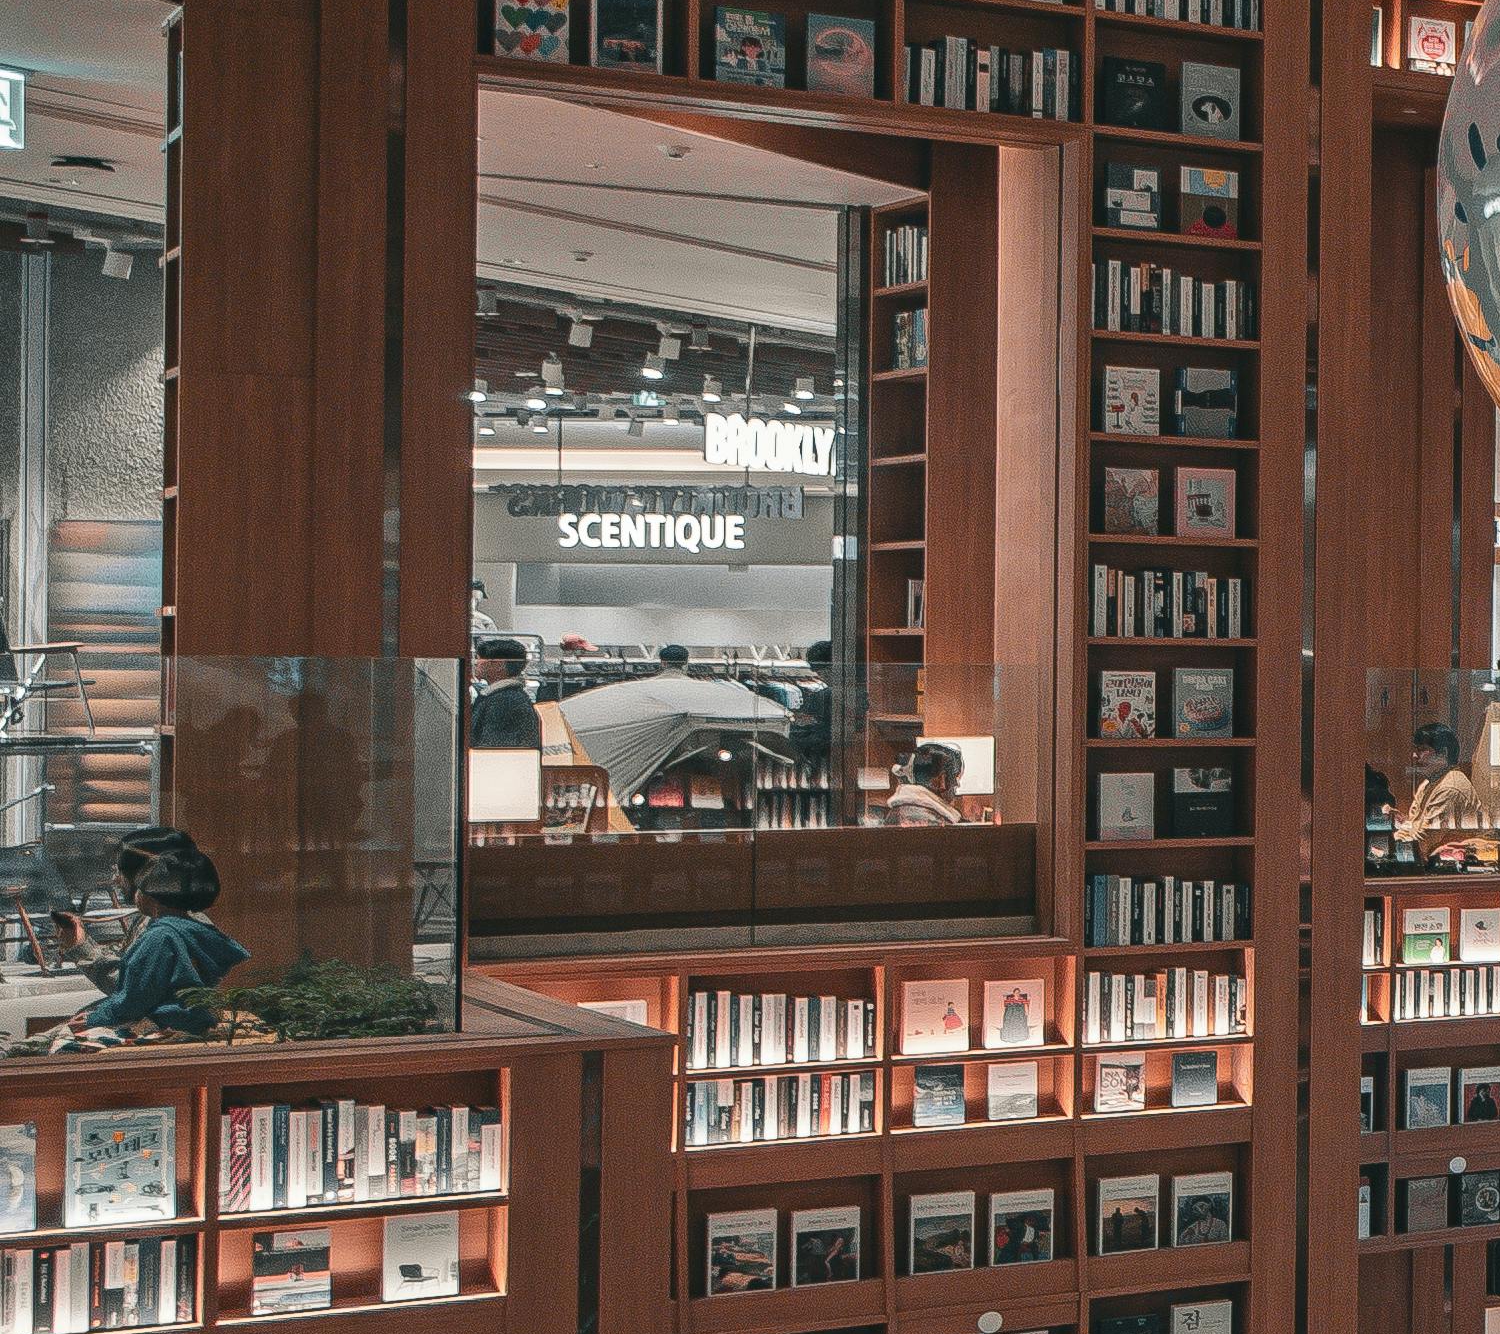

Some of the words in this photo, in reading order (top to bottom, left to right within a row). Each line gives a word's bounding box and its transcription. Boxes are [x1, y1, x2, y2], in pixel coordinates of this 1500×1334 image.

[704, 413, 837, 476] BROOKLY
[559, 513, 745, 554] SCENTIQUE
[235, 1122, 249, 1157] ZERO
